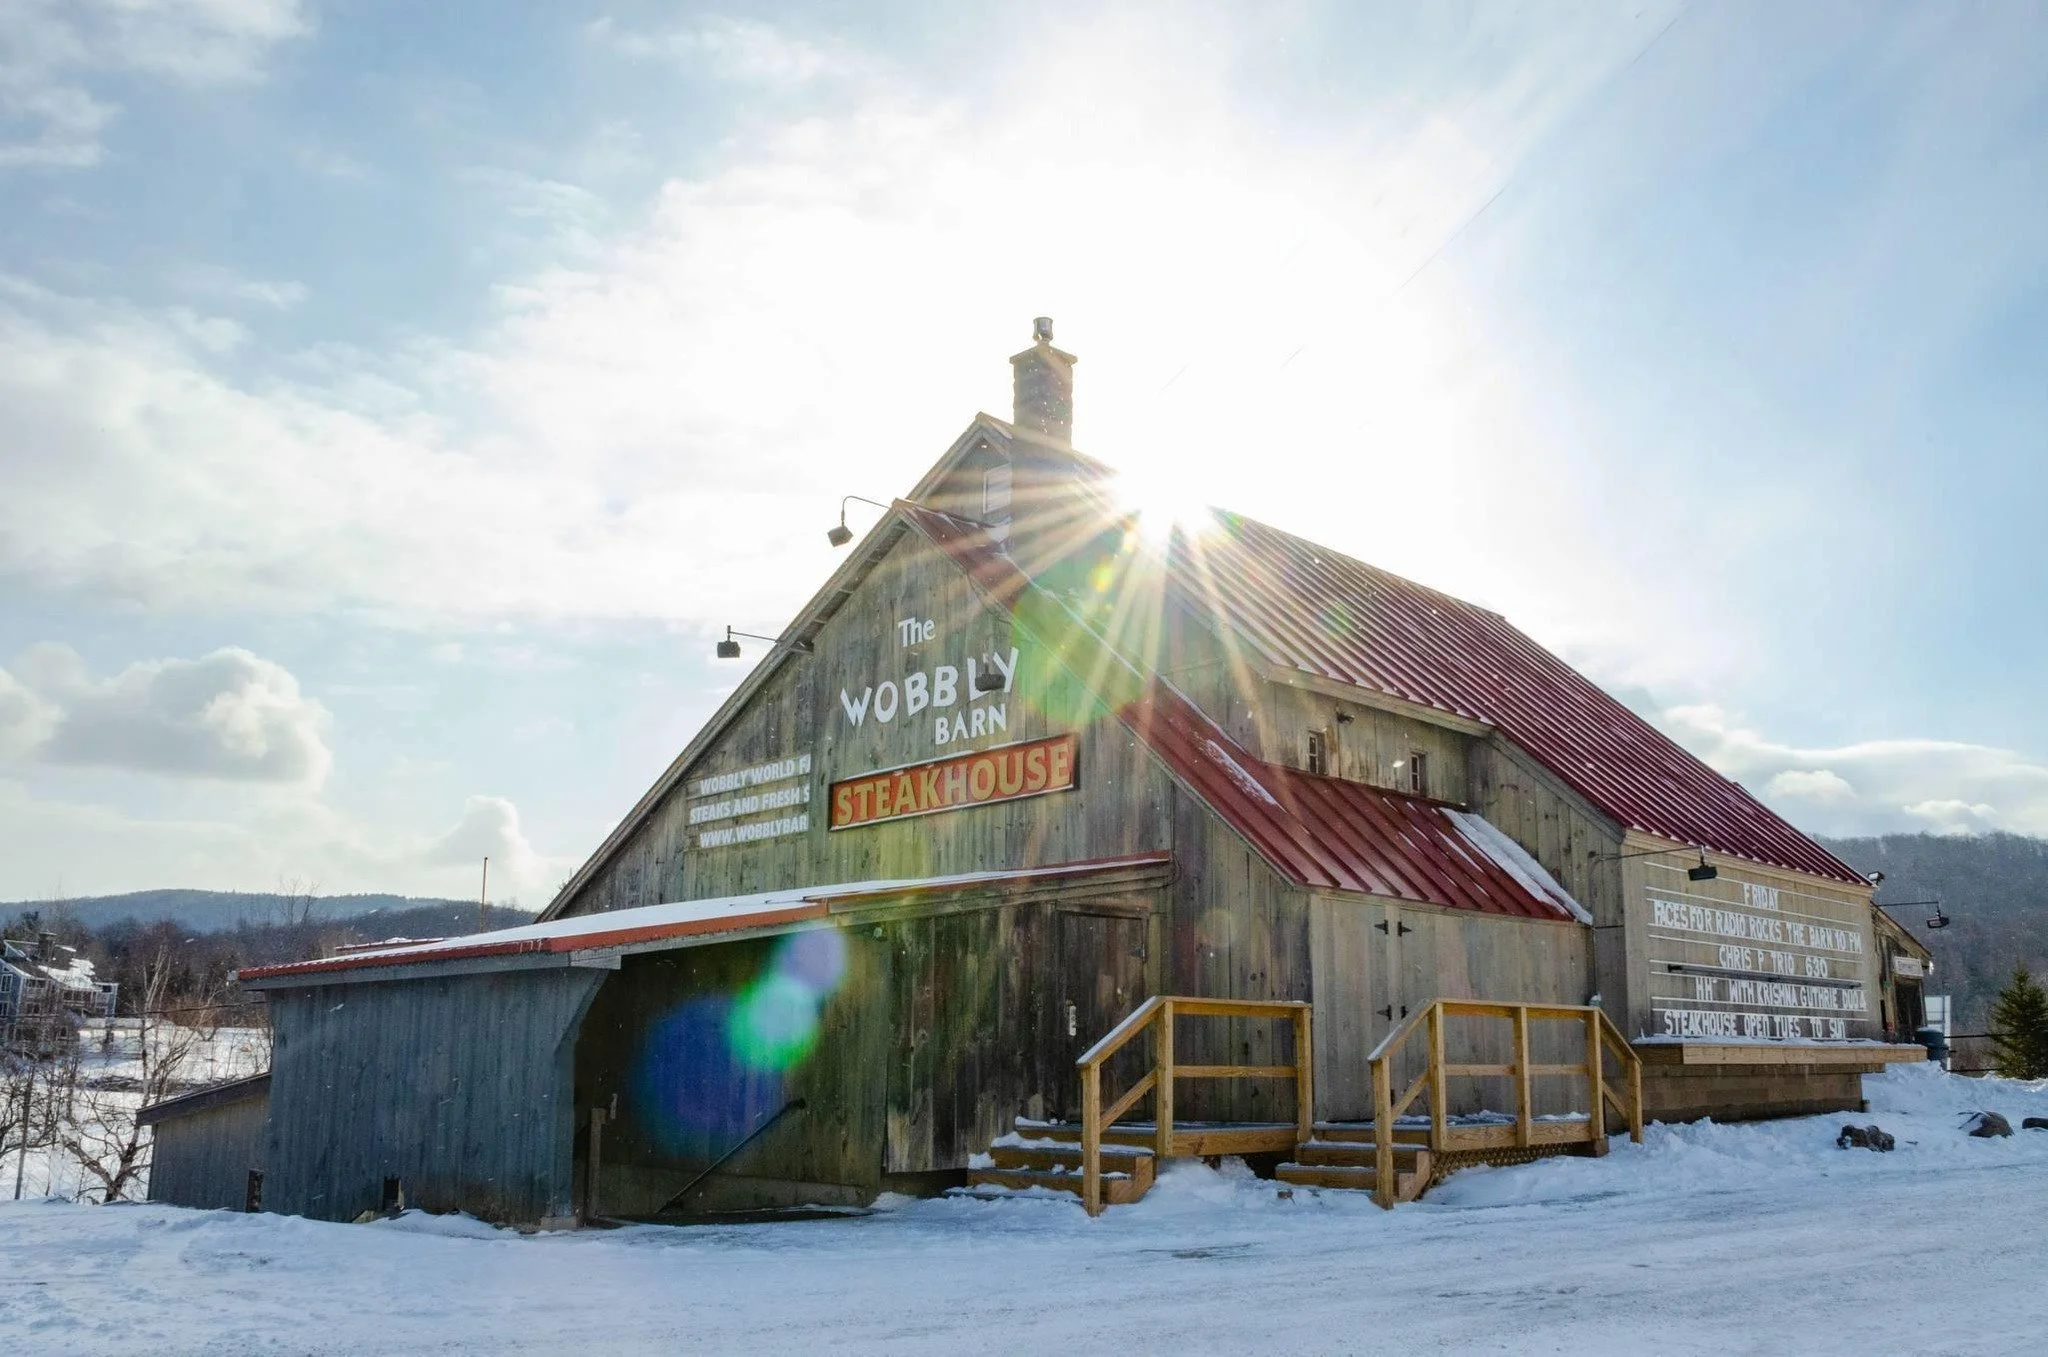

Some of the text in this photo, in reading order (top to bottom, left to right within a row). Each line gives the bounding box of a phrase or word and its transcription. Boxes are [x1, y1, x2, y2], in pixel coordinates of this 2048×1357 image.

[898, 617, 936, 647] The
[840, 647, 1019, 727] WOBBLY
[935, 703, 1006, 745] BARN
[700, 772, 748, 794] WOBBLY
[750, 760, 794, 782] WORLD
[836, 743, 1070, 826] STEAKHOUSE
[690, 801, 731, 824] STEAKS
[734, 796, 758, 814] AND
[762, 788, 800, 808] FRESH
[700, 814, 808, 848] WWW.WOBBLYBAR
[1743, 883, 1779, 910] FRIDAY
[1690, 906, 1712, 932] FOR
[1716, 911, 1746, 937] RADIO
[1750, 918, 1781, 940] ROCKS
[1786, 923, 1804, 944] THE
[1849, 933, 1862, 953] PM
[1719, 945, 1828, 977] CHRIS P TRIO 630
[1729, 980, 1754, 1004] WITH
[1756, 983, 1797, 1006] KRISHNA
[1800, 988, 1838, 1009] GUTHRIE
[1663, 1010, 1736, 1036] STEAKHOUSE
[1774, 1017, 1801, 1037] TUES
[1810, 1018, 1822, 1037] TO
